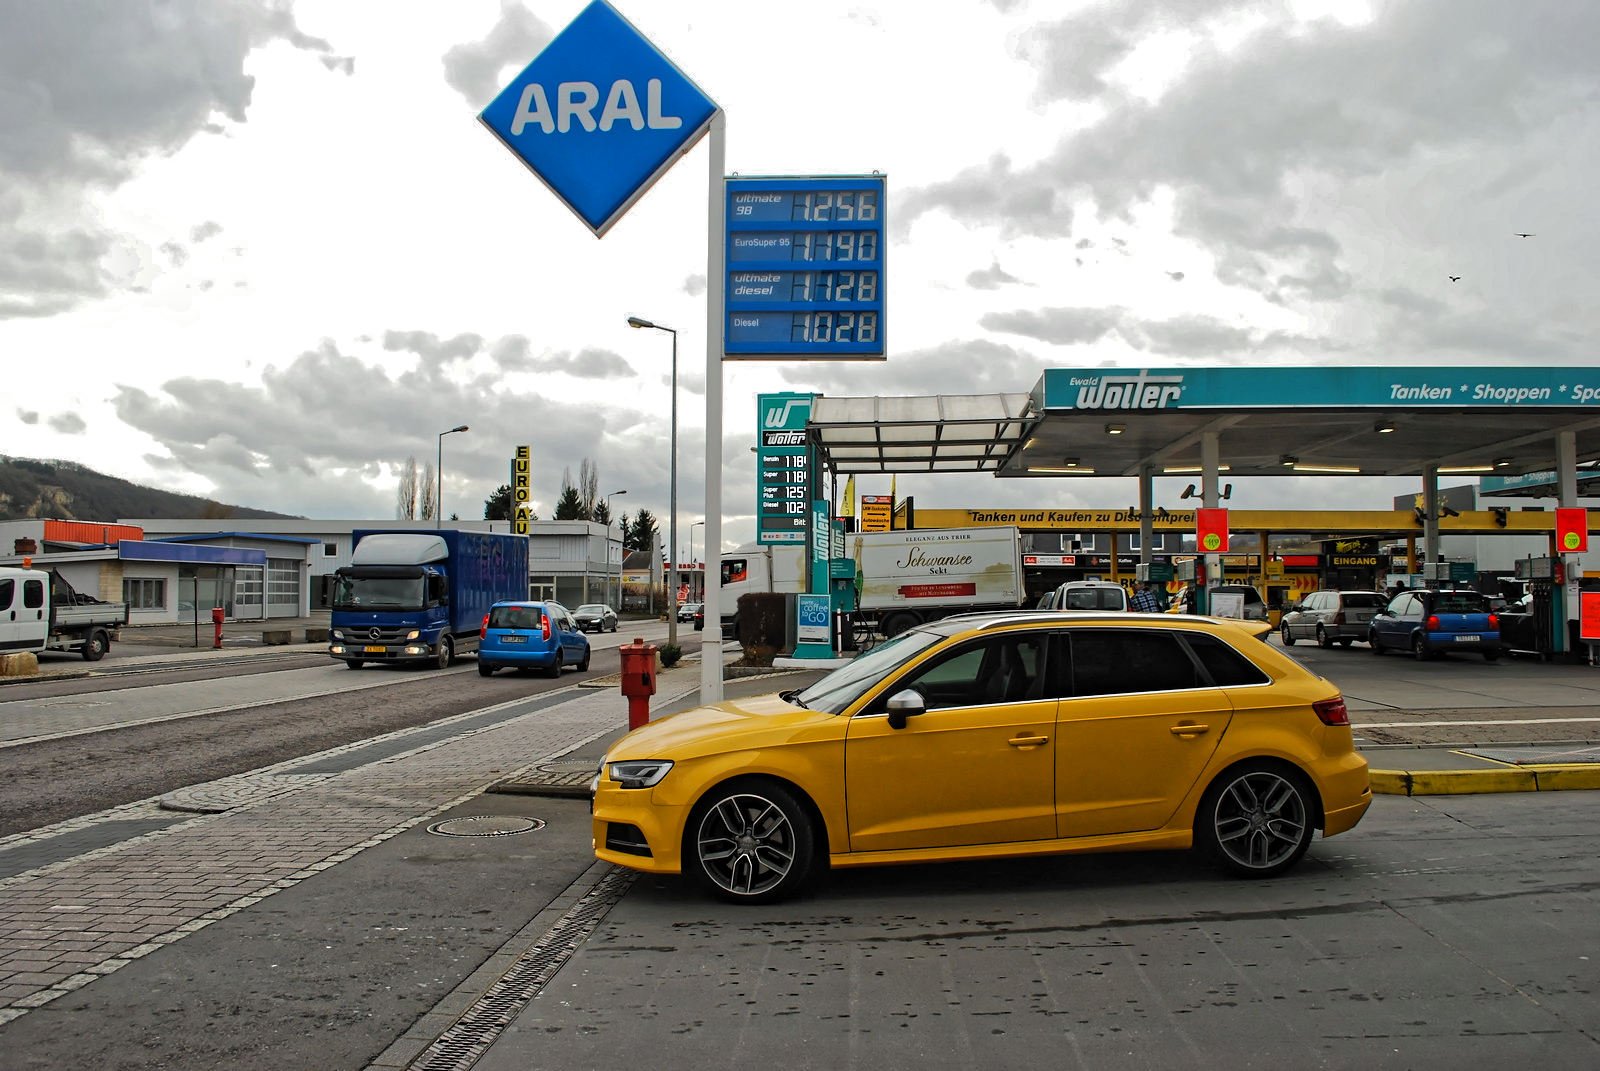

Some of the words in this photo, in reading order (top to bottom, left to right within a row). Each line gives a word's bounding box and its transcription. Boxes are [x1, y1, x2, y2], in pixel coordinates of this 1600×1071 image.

[510, 78, 682, 136] ARAL
[736, 206, 752, 215] 98
[735, 239, 777, 248] EuroSuper
[779, 238, 790, 247] 95
[734, 285, 773, 295] diesel
[734, 318, 759, 327] Diesel
[1069, 377, 1099, 386] Ewald
[1076, 369, 1183, 409] Wolter
[1390, 384, 1452, 399] Tanken
[1472, 384, 1551, 403] Shoppen
[516, 446, 528, 501] EURO
[971, 511, 1016, 523] Tanken
[1020, 511, 1044, 522] und
[1047, 511, 1092, 523] Kaufen
[1096, 514, 1111, 522] zu
[896, 546, 973, 569] Schwansee
[1333, 557, 1377, 565] EINGANG
[929, 566, 948, 575] Sekt
[803, 603, 829, 613] coffee
[808, 611, 826, 623] GO
